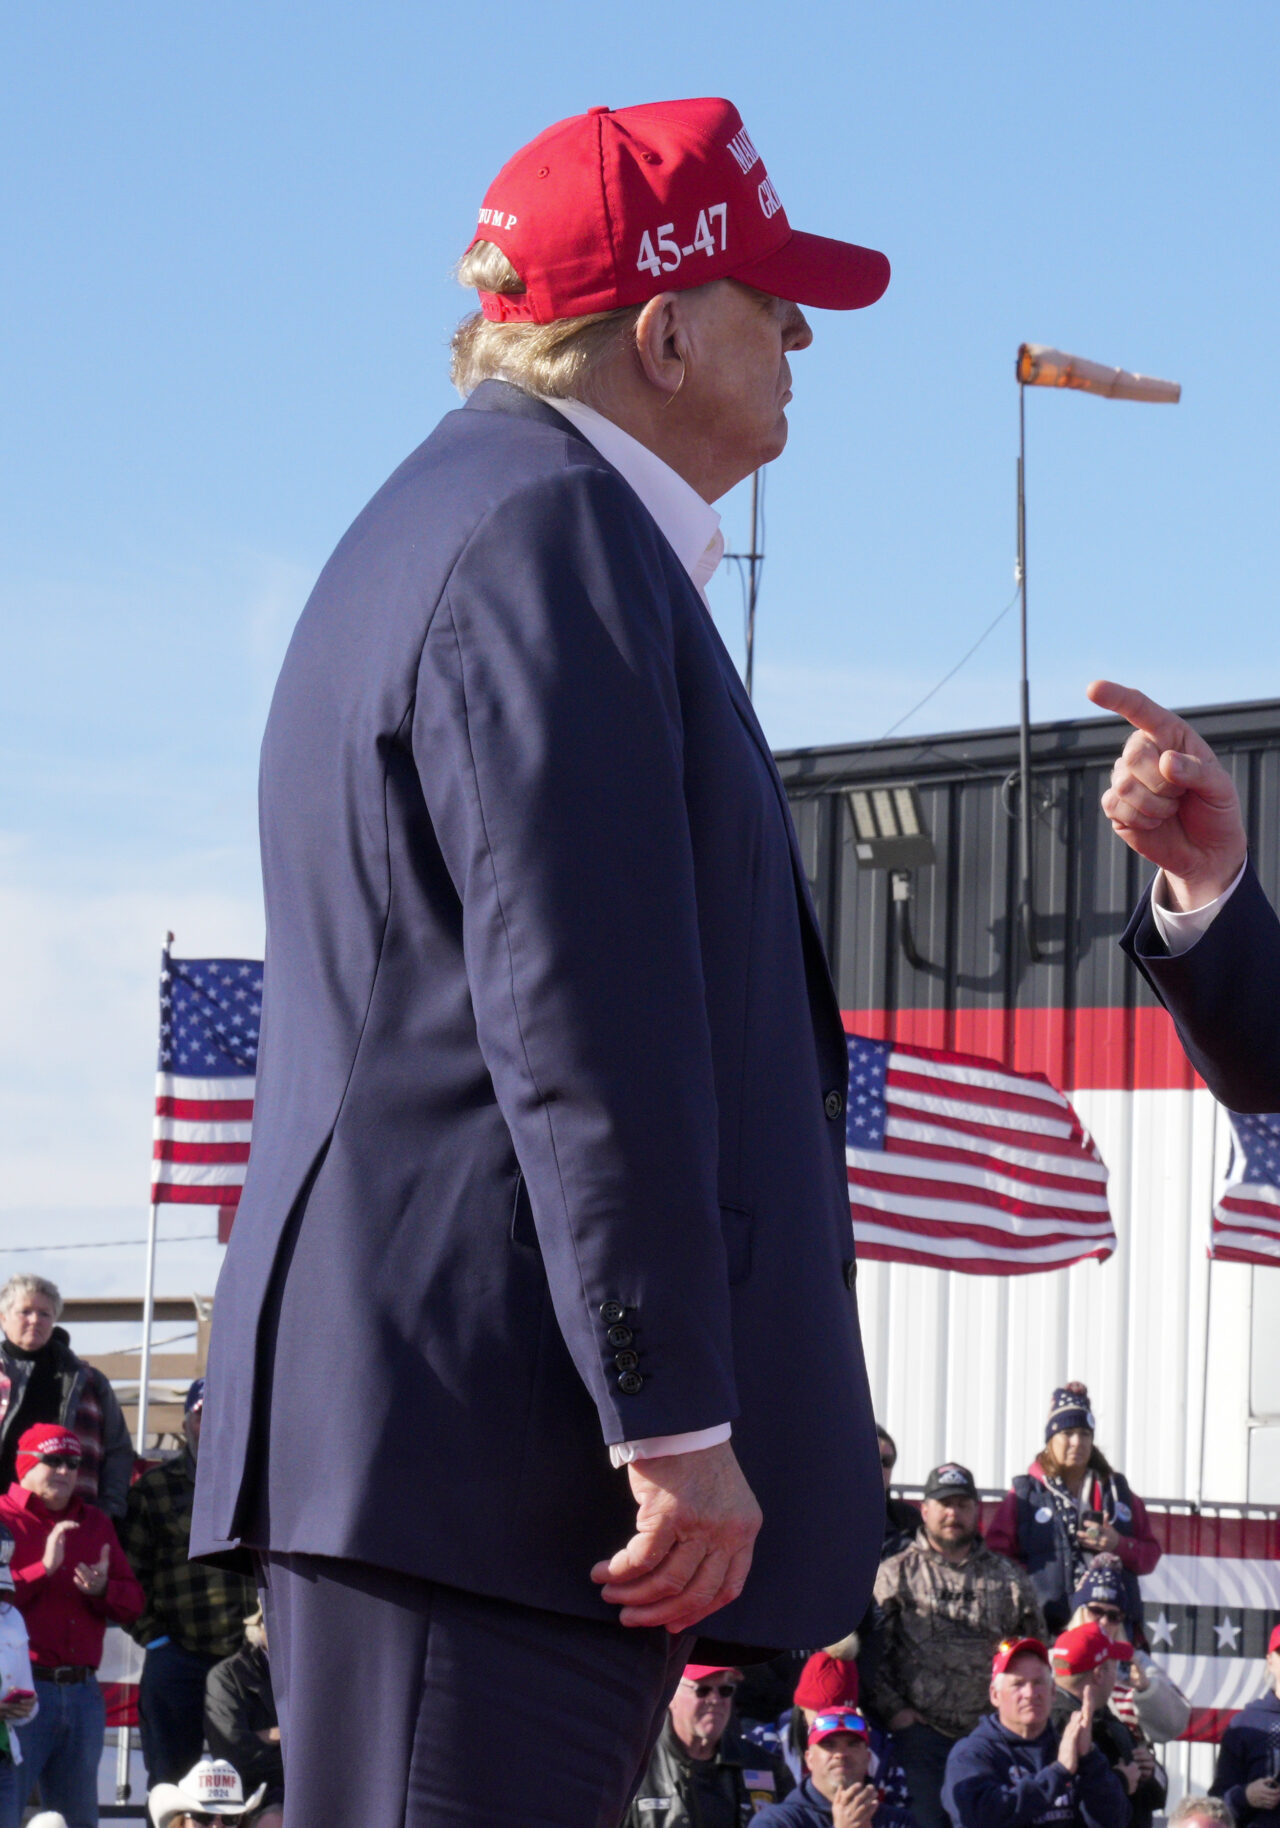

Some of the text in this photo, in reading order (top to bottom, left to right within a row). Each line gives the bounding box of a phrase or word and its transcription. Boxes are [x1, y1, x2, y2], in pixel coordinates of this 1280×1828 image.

[636, 202, 727, 278] 45-47
[199, 1774, 237, 1789] TRUMP
[208, 1789, 229, 1799] 2024
